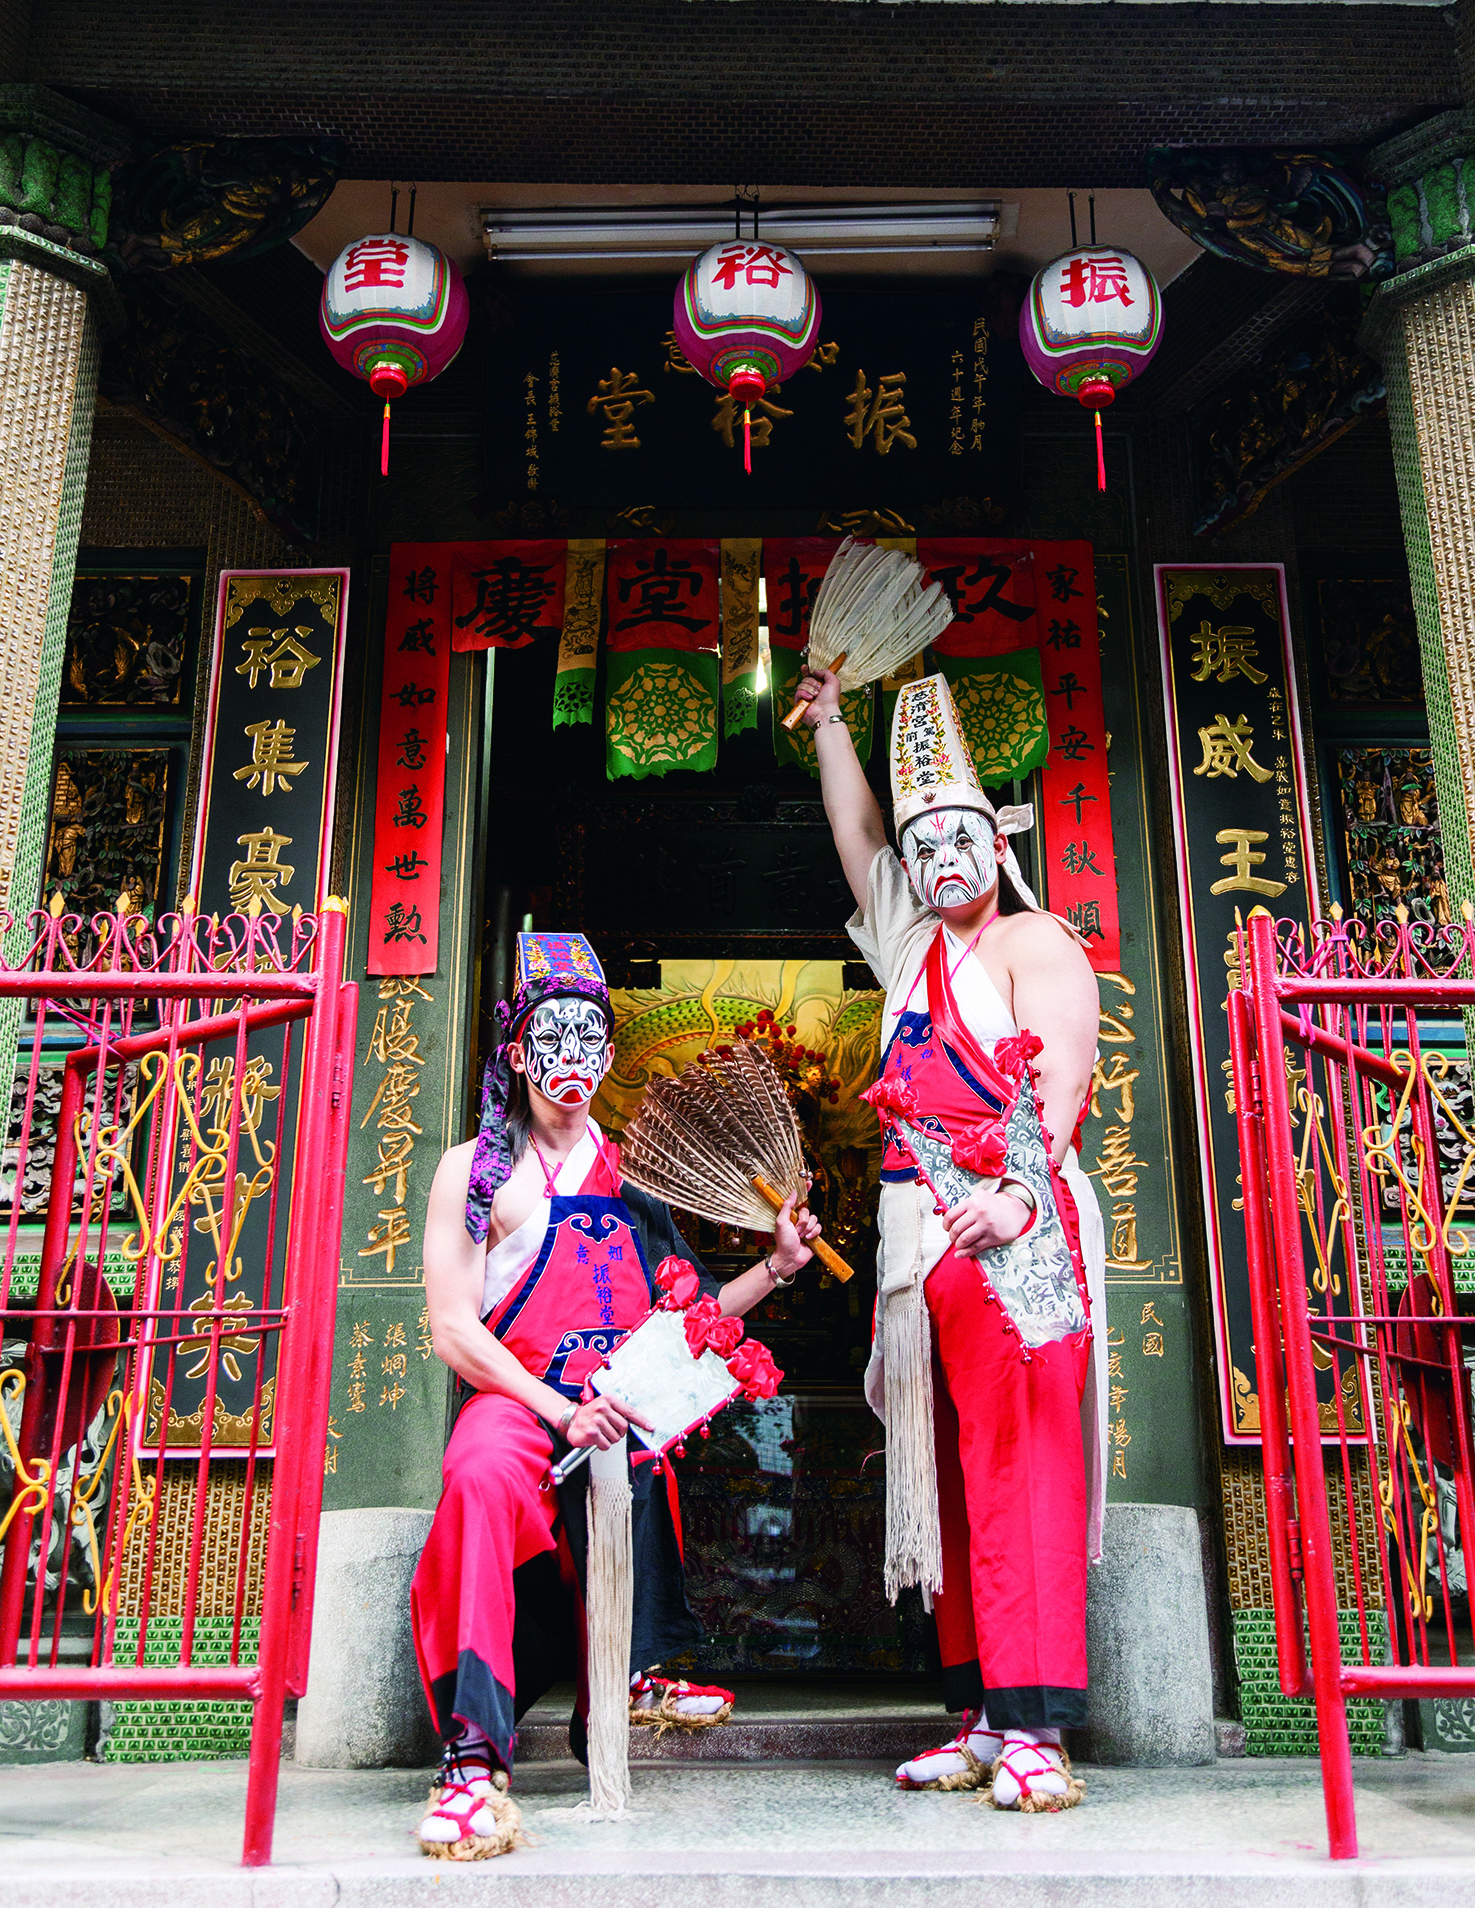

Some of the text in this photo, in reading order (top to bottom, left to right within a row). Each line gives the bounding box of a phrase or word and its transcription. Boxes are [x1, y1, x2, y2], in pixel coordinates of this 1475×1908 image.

[342, 237, 411, 293] 堂
[709, 244, 795, 291] 裕
[1059, 256, 1136, 310] 振
[912, 738, 936, 787] 振裕堂
[574, 1242, 623, 1265] 如意
[592, 1263, 615, 1326] 振裕堂
[1139, 1301, 1164, 1358] 民國
